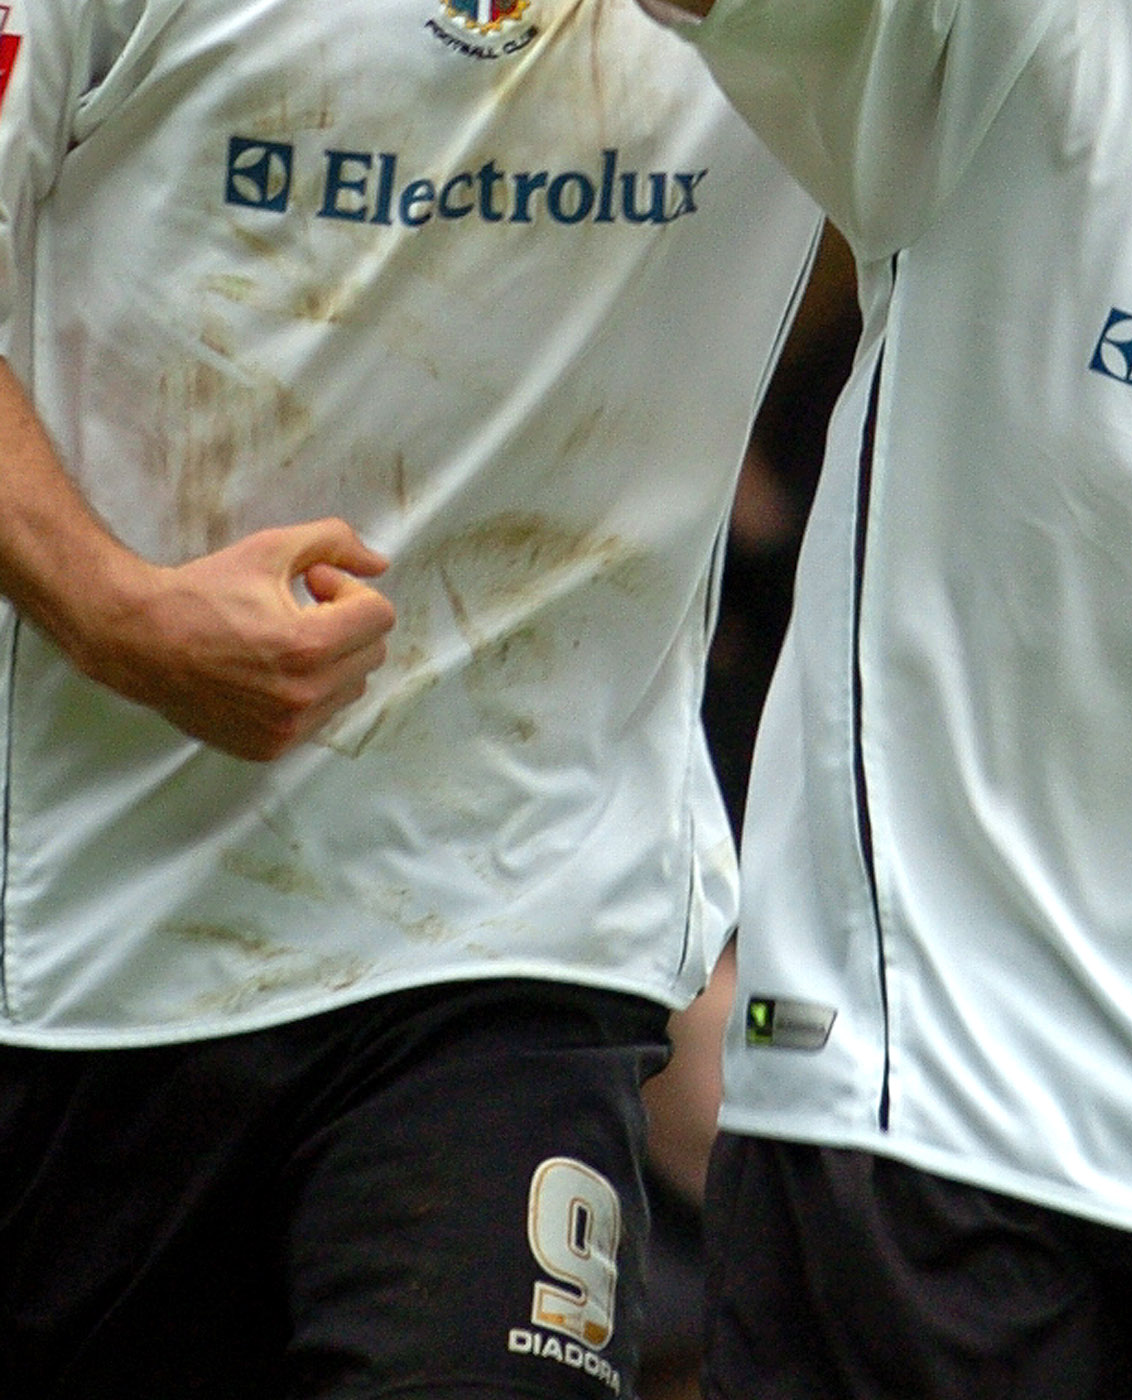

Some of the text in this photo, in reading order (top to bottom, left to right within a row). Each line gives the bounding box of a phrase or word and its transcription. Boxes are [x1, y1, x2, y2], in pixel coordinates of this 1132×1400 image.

[316, 149, 709, 227] Electrolux
[527, 1156, 621, 1351] 9
[507, 1328, 621, 1398] DIADORA
